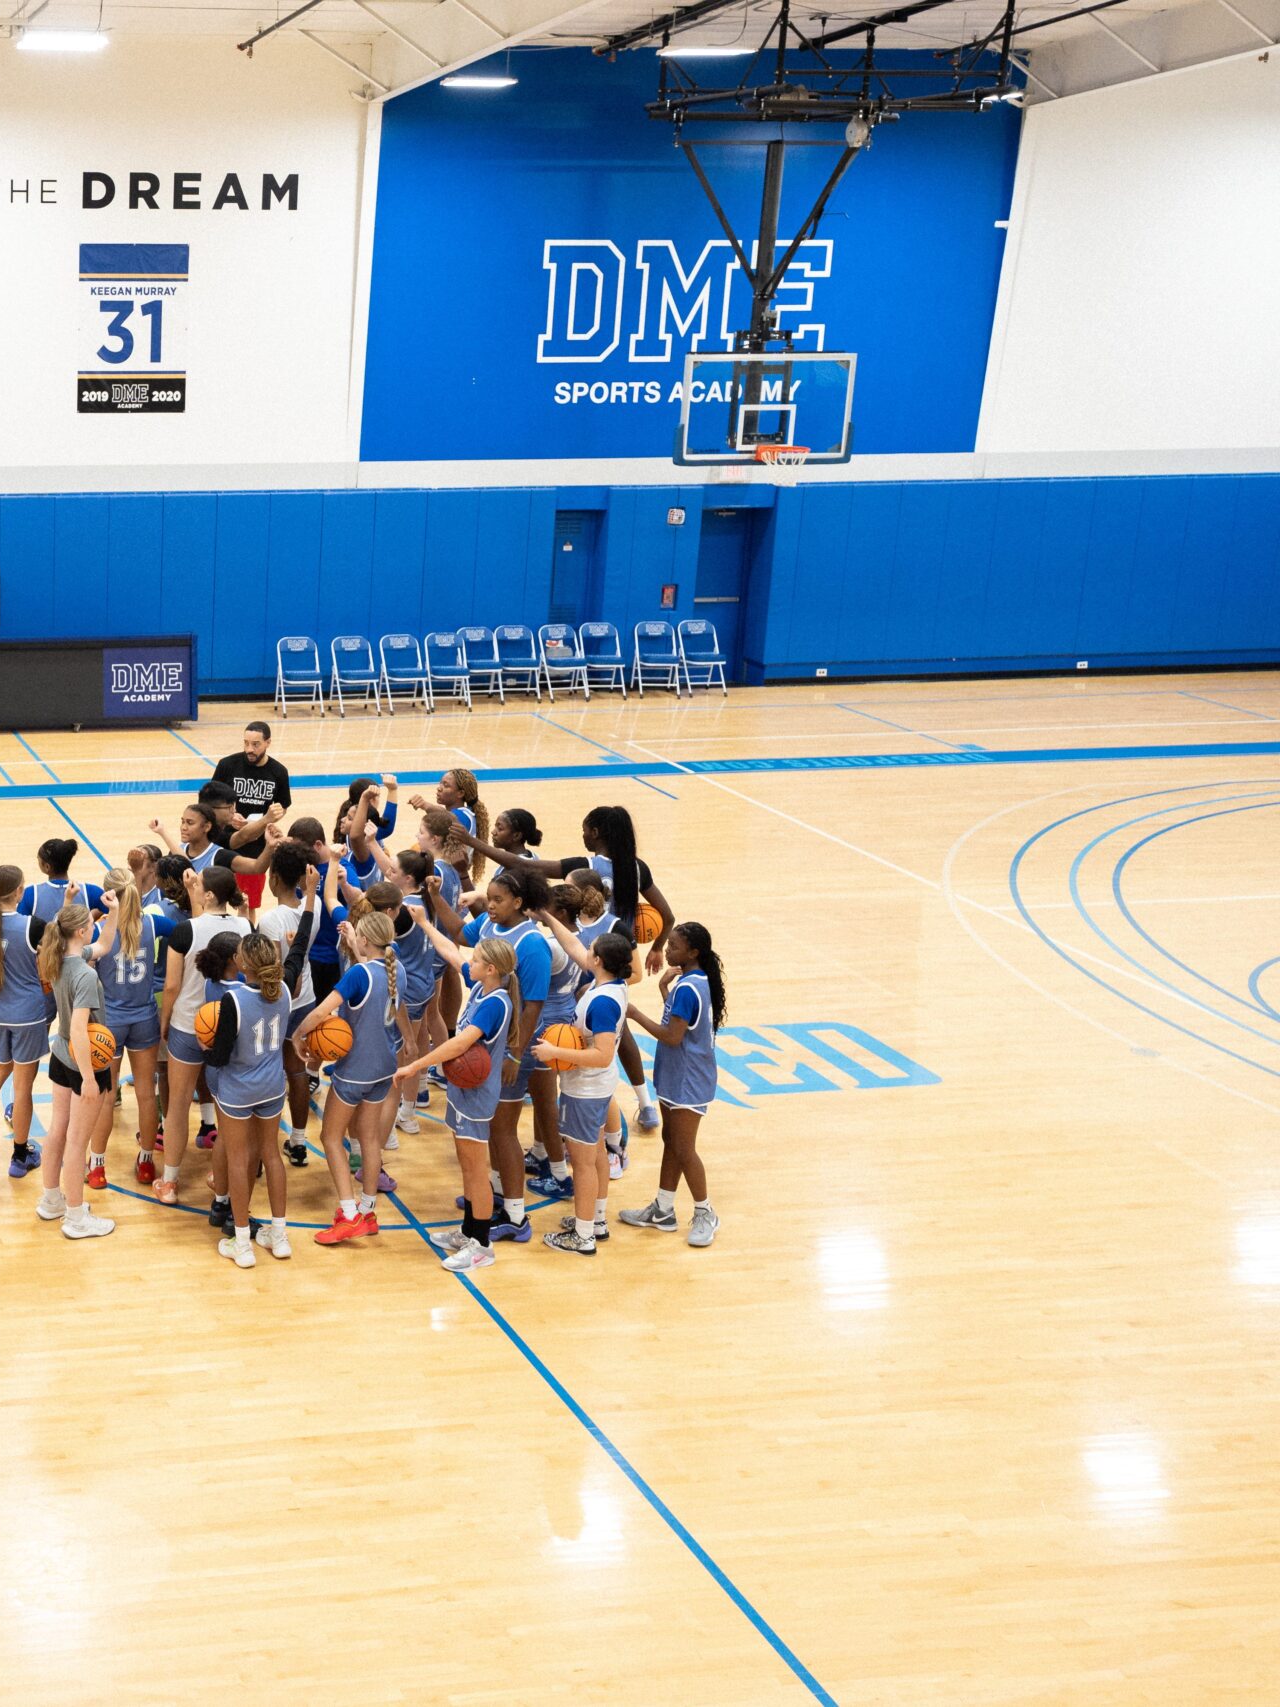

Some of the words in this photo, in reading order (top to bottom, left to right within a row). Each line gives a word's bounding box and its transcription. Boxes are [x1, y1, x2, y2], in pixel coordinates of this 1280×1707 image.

[81, 172, 300, 211] DREAM
[90, 287, 132, 296] KEEGAN
[135, 287, 177, 296] MURRAY
[537, 239, 834, 364] DME
[96, 299, 163, 365] 31
[81, 390, 109, 403] 2019
[111, 383, 149, 403] DME
[151, 390, 182, 403] 2020
[553, 381, 661, 404] SPORTS
[668, 379, 802, 403] ACADMY
[111, 663, 182, 693] DME
[123, 694, 172, 702] ACADEMY
[233, 777, 275, 800] DME
[113, 947, 147, 984] 15
[252, 1014, 280, 1055] 11
